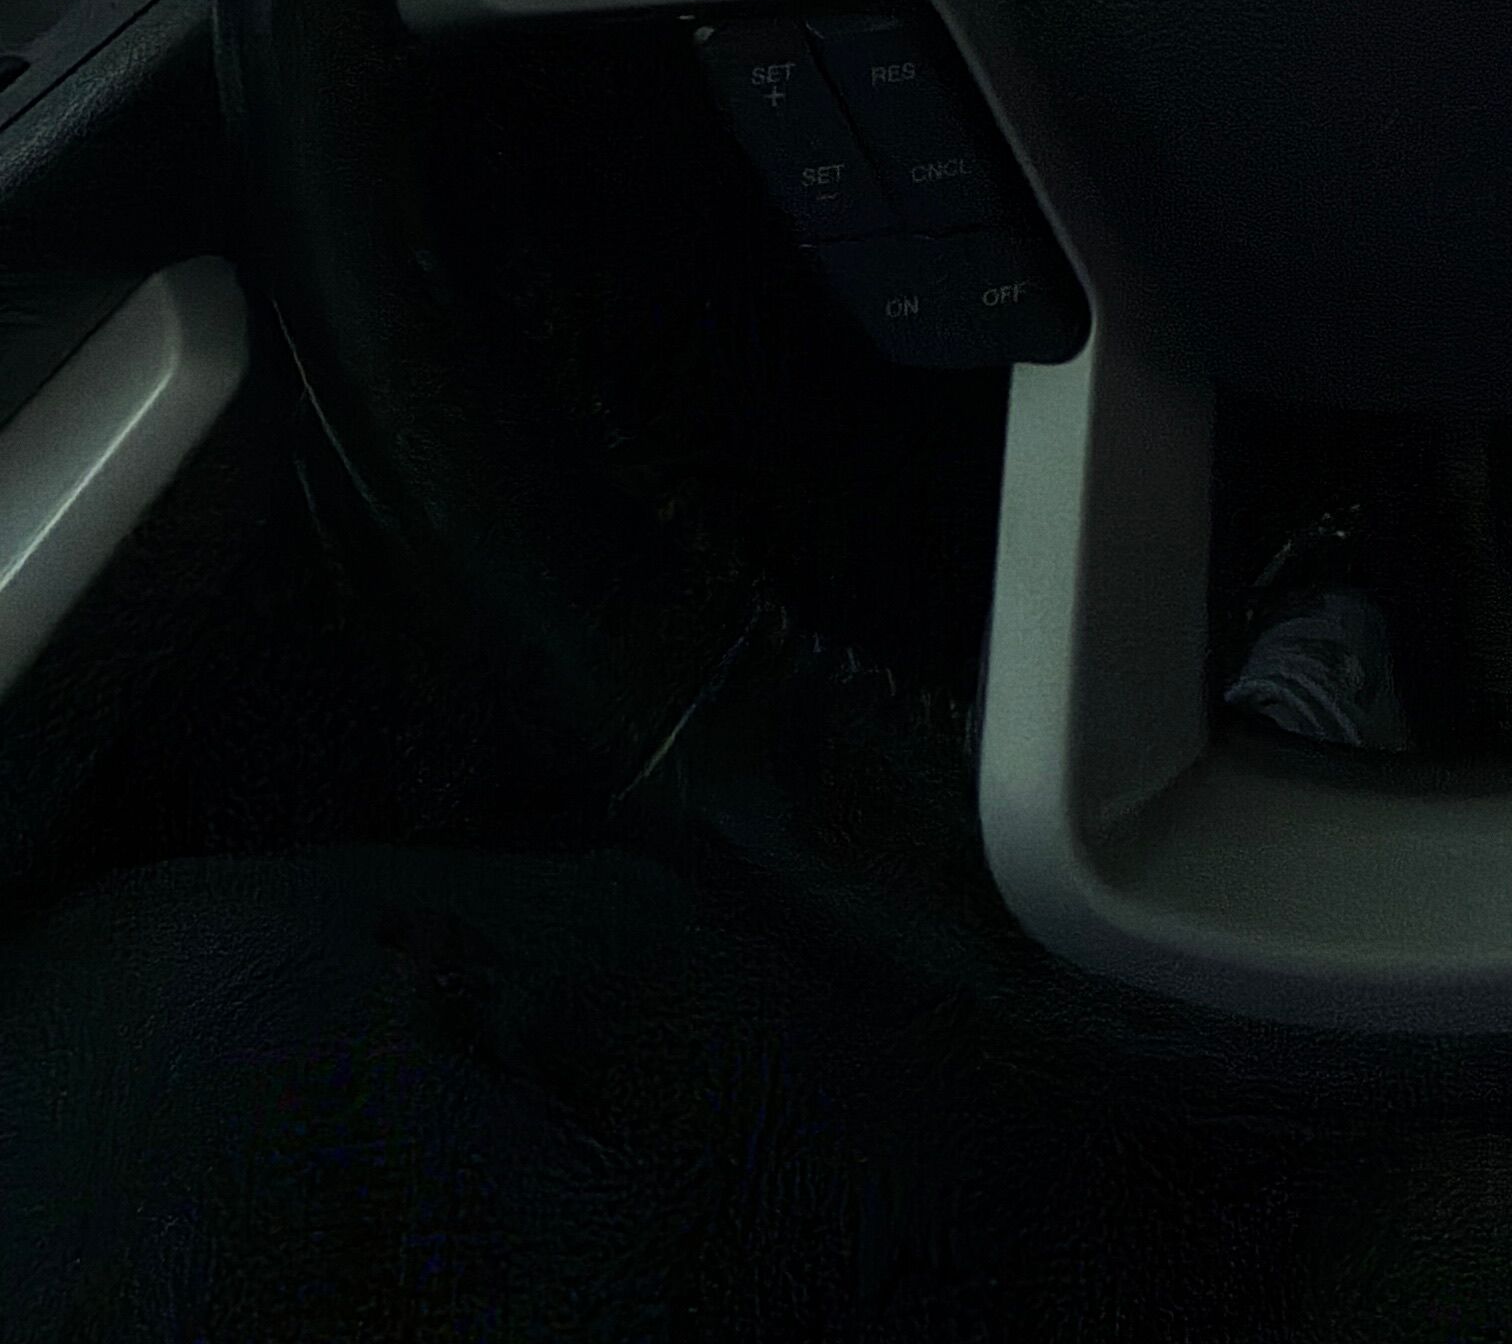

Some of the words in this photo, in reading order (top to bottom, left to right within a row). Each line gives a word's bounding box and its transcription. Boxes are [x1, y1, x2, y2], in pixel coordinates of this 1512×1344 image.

[751, 62, 796, 87] SET
[871, 62, 916, 86] RES
[802, 164, 846, 187] SET
[981, 282, 1026, 308] OFF
[885, 297, 919, 318] ON
